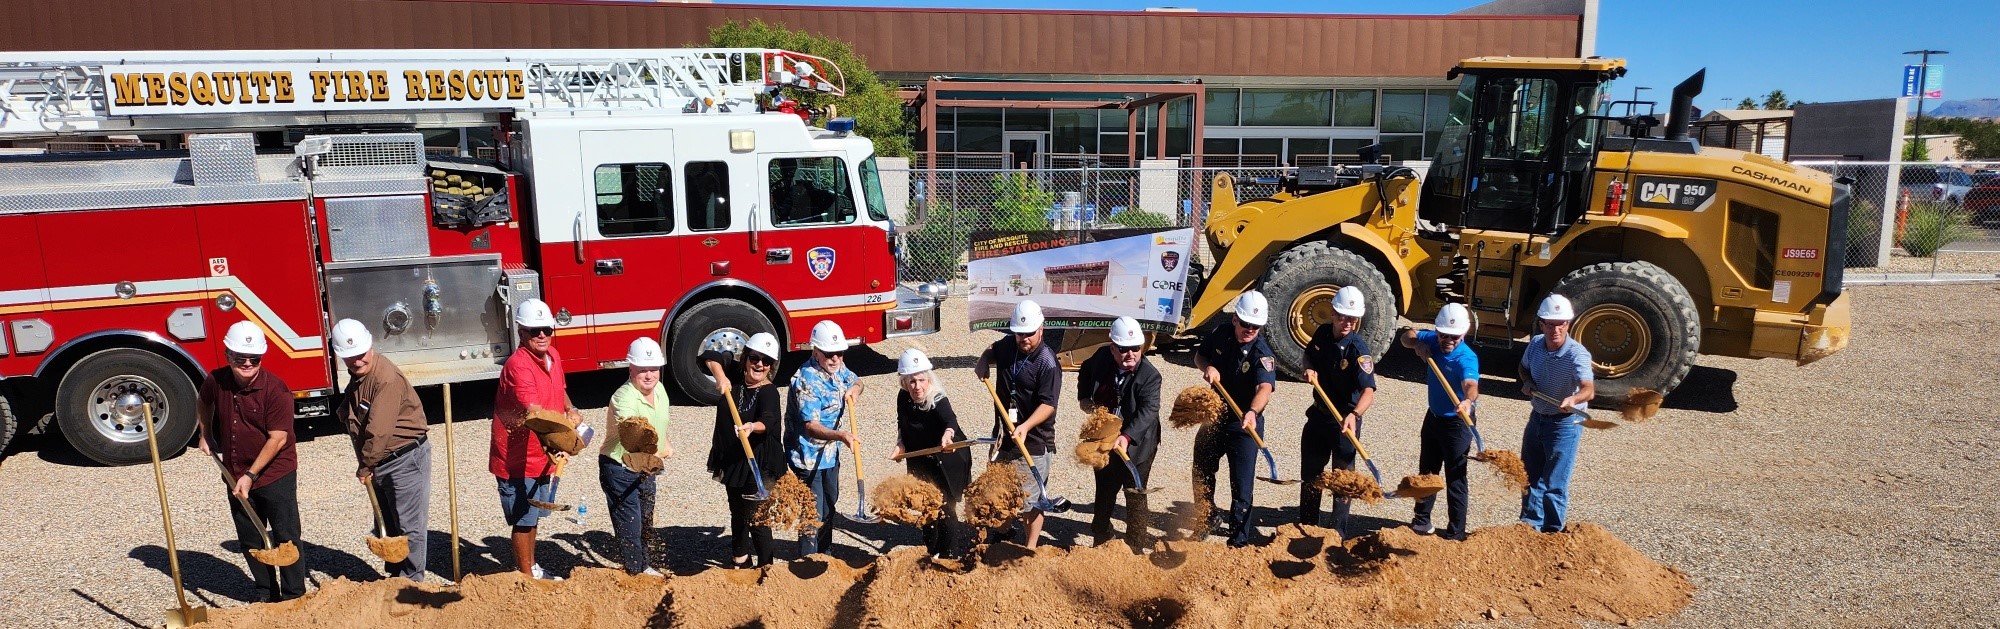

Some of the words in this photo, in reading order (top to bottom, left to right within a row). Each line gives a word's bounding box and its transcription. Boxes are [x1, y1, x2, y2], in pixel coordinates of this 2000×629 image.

[110, 71, 295, 106] MESQUITE
[309, 70, 390, 102] FIRE
[403, 69, 525, 101] RESCUE
[1731, 165, 1811, 194] CASHMAN
[1640, 181, 1680, 204] CAT
[1683, 184, 1706, 196] 950
[997, 234, 1028, 243] MESQUITE
[1004, 239, 1029, 247] RESCUE
[975, 249, 1000, 259] FIRE
[1002, 242, 1048, 255] STATION
[1784, 249, 1816, 258] JS9E65
[1152, 280, 1183, 291] CORE
[866, 295, 882, 303] 226
[972, 320, 1009, 329] INTEGRITY
